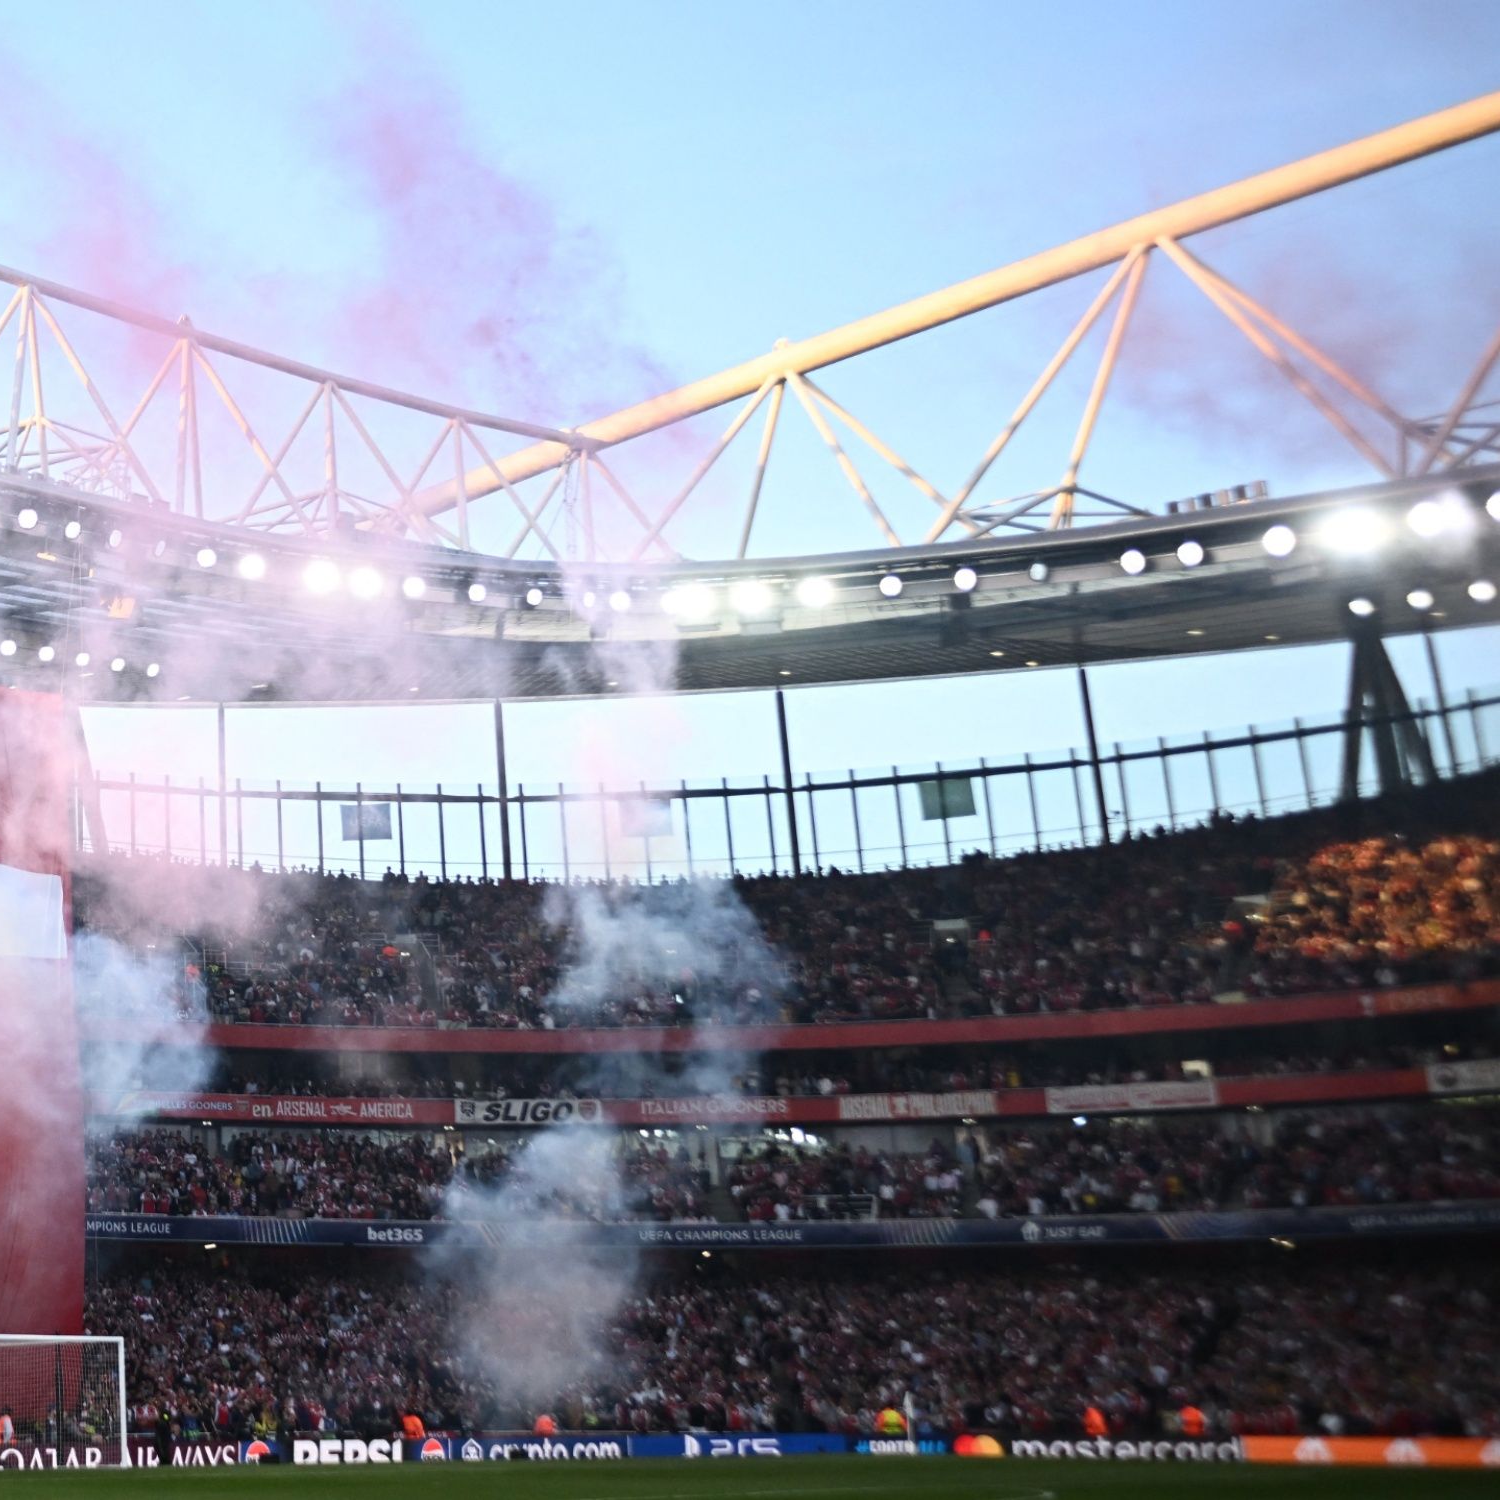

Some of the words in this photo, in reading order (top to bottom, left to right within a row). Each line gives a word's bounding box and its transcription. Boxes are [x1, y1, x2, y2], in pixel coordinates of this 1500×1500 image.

[189, 1100, 233, 1111] GOONERS
[276, 1101, 328, 1118] ARSENAL
[359, 1102, 414, 1119] AMERICA
[482, 1101, 574, 1122] SLIGO
[86, 1220, 127, 1234] MPIONS
[131, 1221, 171, 1234] LEAGUE
[367, 1226, 424, 1242] bet365
[638, 1229, 672, 1241] UEFA
[675, 1229, 749, 1241] CHAMPIONS
[753, 1229, 802, 1241] LEAGUE
[293, 1438, 403, 1465] PEPSI
[489, 1438, 622, 1461] crptocom
[710, 1437, 782, 1457] PS5
[1011, 1435, 1242, 1461] mastercard
